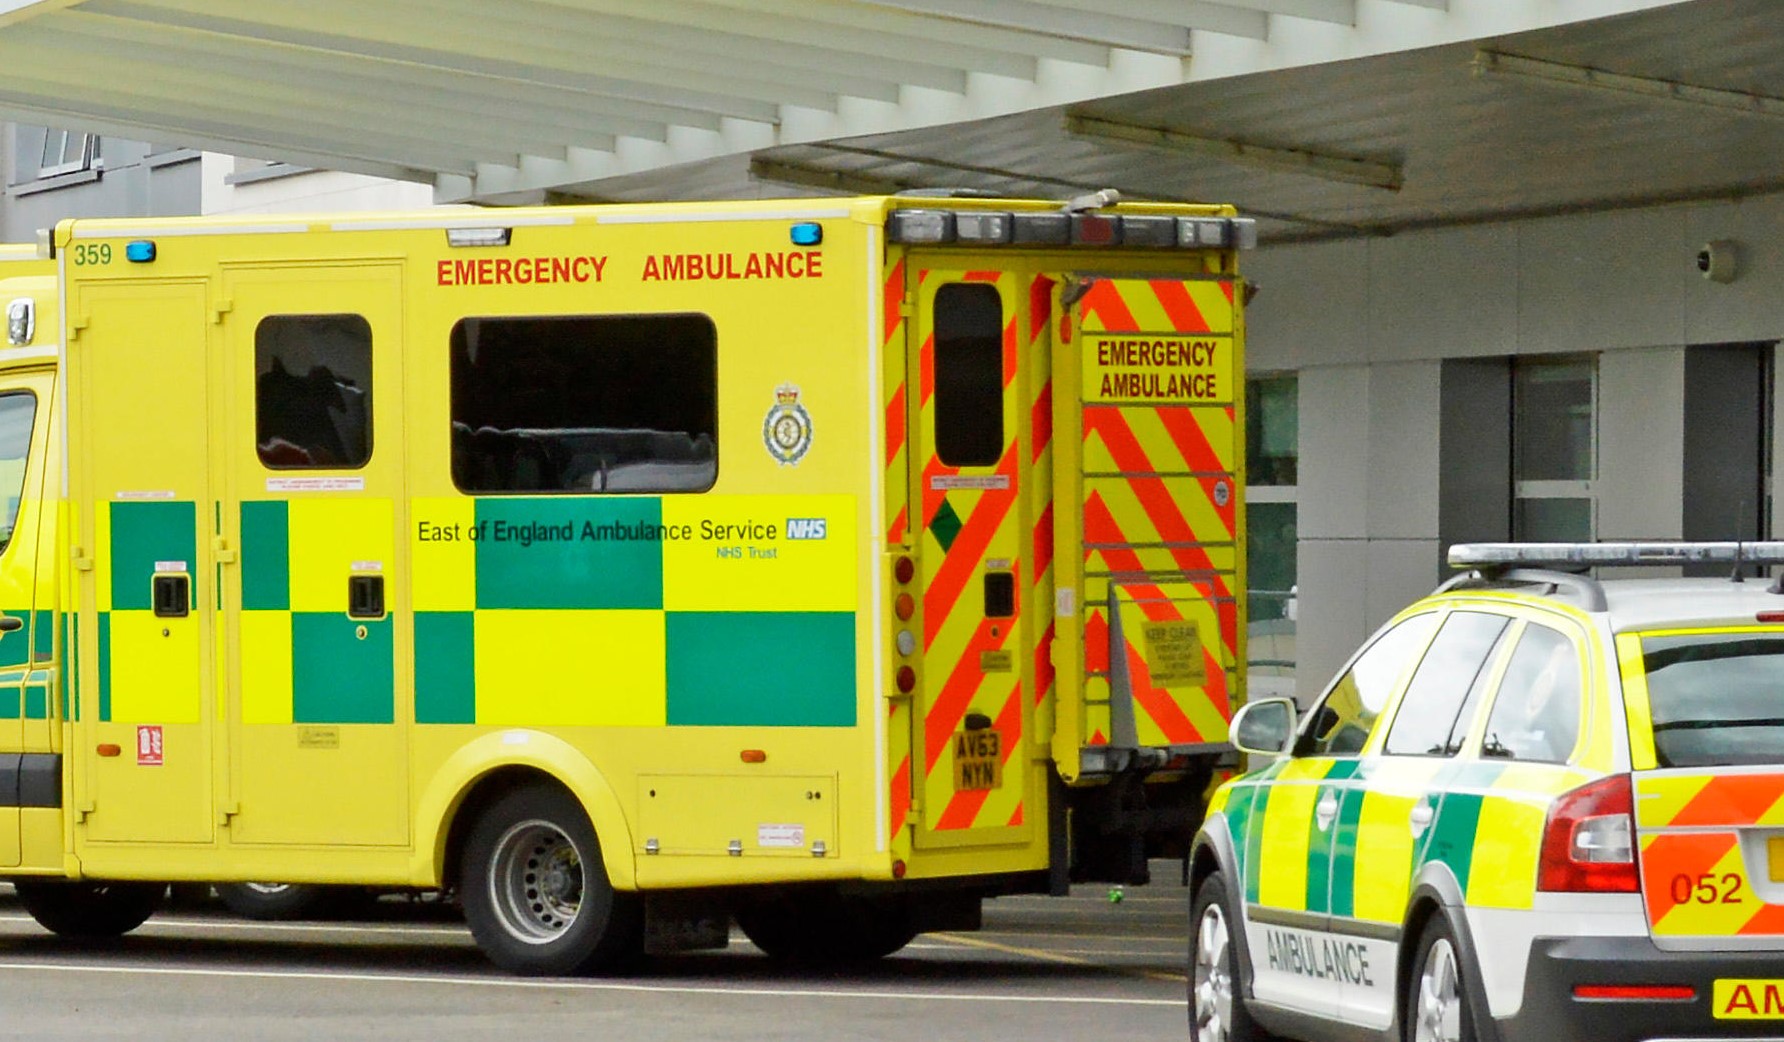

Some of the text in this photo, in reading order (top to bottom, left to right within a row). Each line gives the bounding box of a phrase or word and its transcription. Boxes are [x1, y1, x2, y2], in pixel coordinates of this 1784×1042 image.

[74, 243, 112, 266] 359
[437, 251, 823, 286] EMERGENCY AMBULANCE
[1097, 340, 1217, 367] EMERGENCY
[1100, 373, 1217, 398] AMBULANCE
[418, 518, 777, 547] East of England Ambulance Service
[786, 518, 827, 540] NHS
[716, 546, 778, 558] NHS Trust
[956, 733, 998, 758] AV63
[962, 761, 993, 787] NYN
[1670, 872, 1743, 905] 052
[1268, 929, 1375, 988] AMBULANCE
